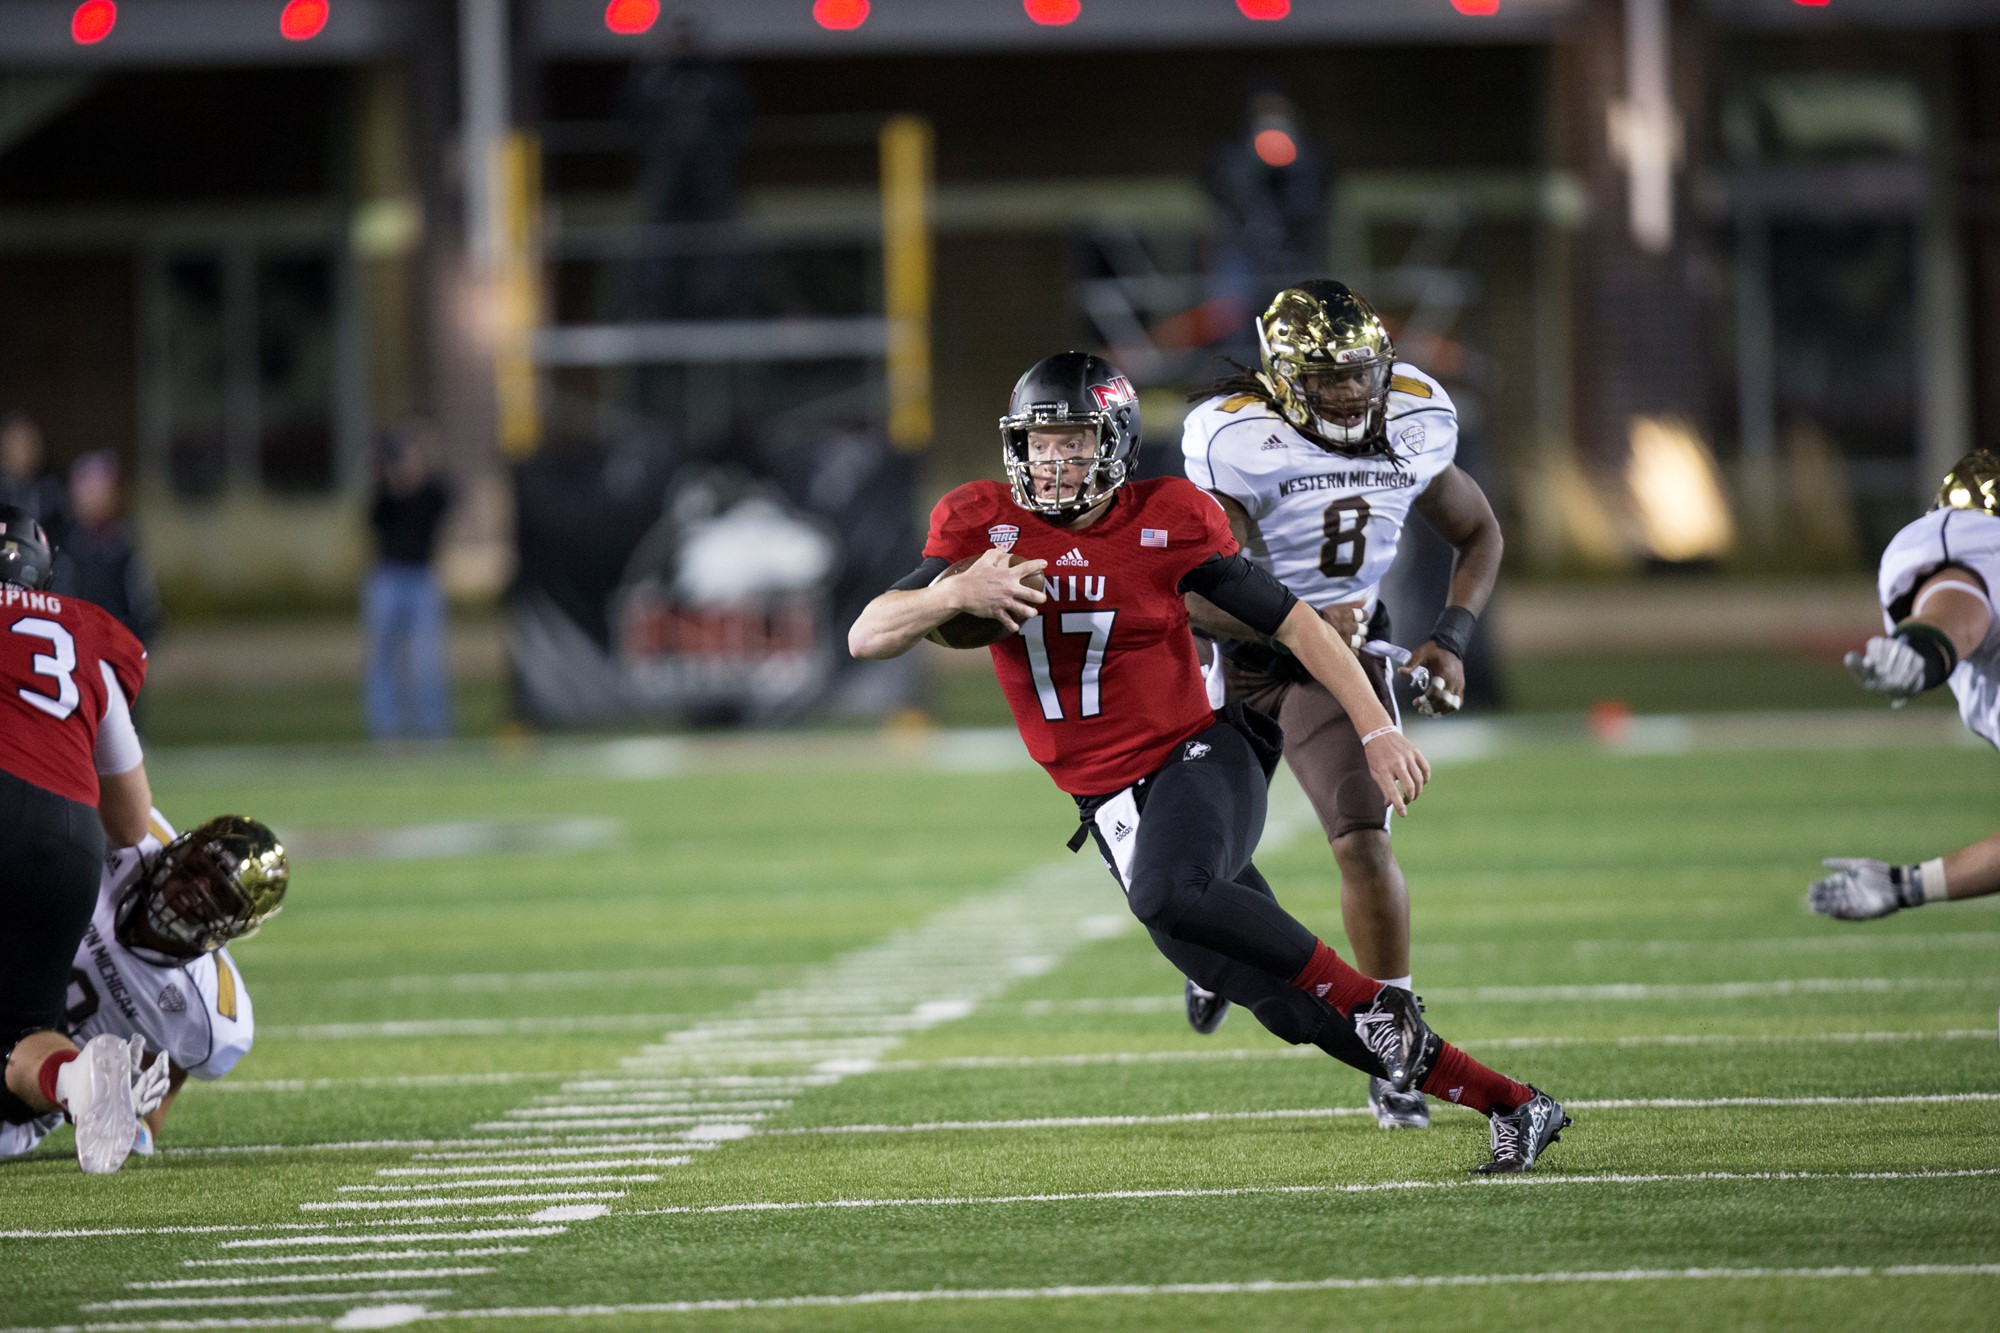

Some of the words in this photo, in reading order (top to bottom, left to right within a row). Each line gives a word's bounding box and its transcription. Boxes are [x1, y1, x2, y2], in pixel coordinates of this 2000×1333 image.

[1279, 471, 1346, 498] WESTERN
[1348, 470, 1417, 488] MICHIGAN
[1056, 558, 1090, 567] adidas
[1319, 496, 1374, 578] 8
[1043, 575, 1106, 602] NIU
[10, 616, 80, 721] 3
[1018, 608, 1119, 722] 17
[91, 944, 139, 1019] MICHIGAN
